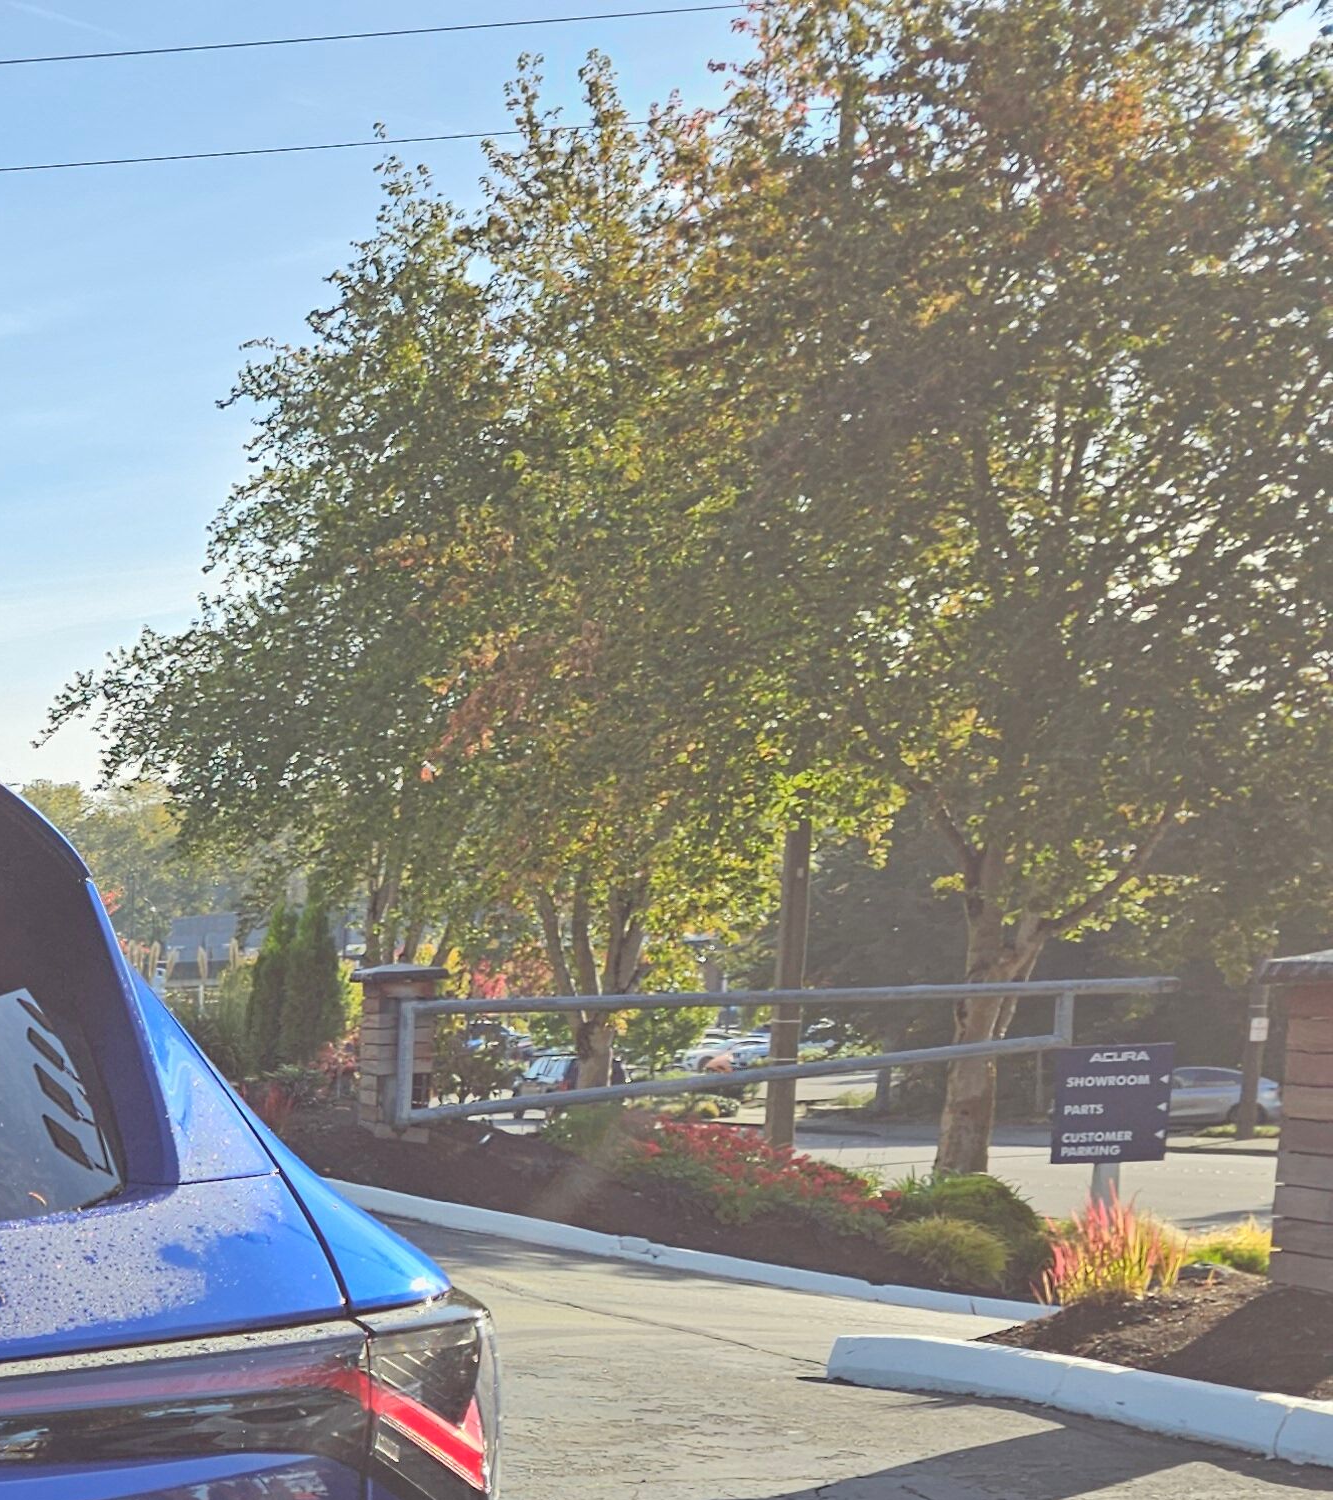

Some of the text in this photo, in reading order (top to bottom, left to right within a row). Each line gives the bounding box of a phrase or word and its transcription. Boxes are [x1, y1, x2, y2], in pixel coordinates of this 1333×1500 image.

[1089, 1050, 1150, 1063] ACURA
[1065, 1074, 1150, 1088] SHOWROOM
[1063, 1104, 1104, 1116] PARTS
[1061, 1131, 1133, 1143] CUSTOMER
[1060, 1145, 1121, 1157] PARKING
